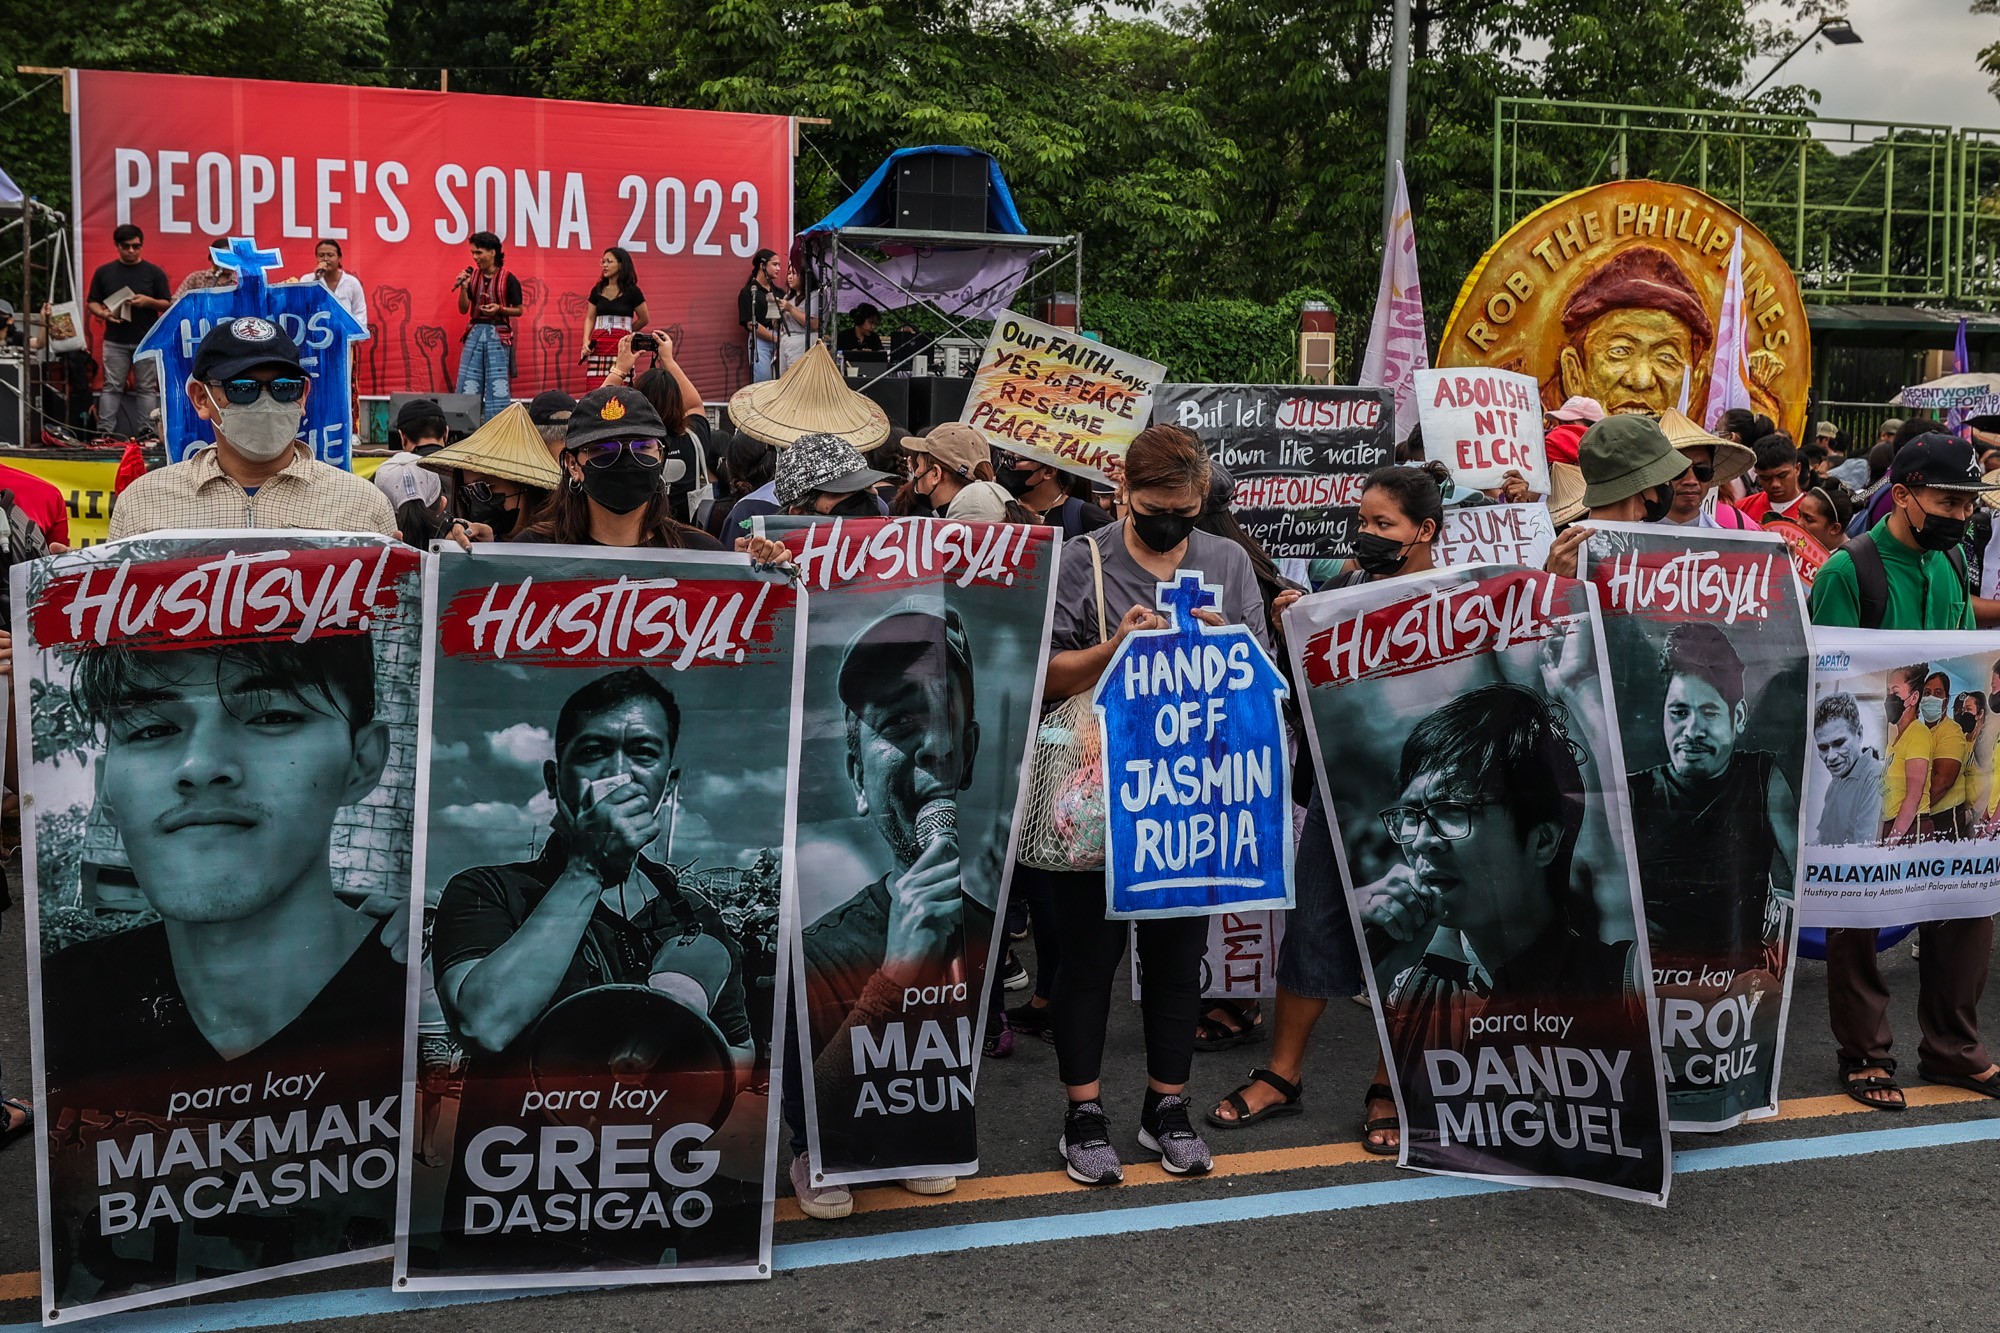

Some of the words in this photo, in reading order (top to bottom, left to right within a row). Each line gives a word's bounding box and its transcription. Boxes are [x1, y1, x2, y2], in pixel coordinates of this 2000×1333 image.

[115, 148, 410, 242] PEOPLE'S
[434, 164, 591, 250] SONA
[618, 175, 760, 257] 2023
[1467, 271, 1535, 351] ROB
[1532, 211, 1603, 272] THE
[180, 311, 334, 358] HDS
[1003, 321, 1045, 350] Our
[1045, 336, 1115, 376] FAITH
[994, 348, 1041, 381] YES
[1045, 371, 1062, 388] to
[1064, 375, 1136, 420] PEACE
[1434, 377, 1530, 412] ABOLISH
[1000, 382, 1104, 436] RESUME
[1177, 400, 1228, 429] But
[1236, 398, 1269, 427] let
[1278, 397, 1382, 428] JUSTICE
[1475, 410, 1518, 438] NTF
[969, 401, 1120, 472] PEACE-TALKS
[1210, 439, 1267, 466] down
[1279, 439, 1317, 466] like
[1323, 439, 1387, 466] water
[1456, 439, 1533, 471] ELCAC
[1260, 539, 1320, 557] tream.
[1432, 508, 1532, 546] ESUME
[1125, 643, 1254, 700] HANDS
[1155, 698, 1227, 747] OFF
[1120, 745, 1272, 812] JASMIN
[1134, 809, 1259, 872] RUBIA
[1803, 887, 1839, 899] Hustisya
[1840, 889, 1862, 899] para
[1864, 888, 1878, 899] kay
[1927, 882, 1959, 894] Palayain
[1960, 880, 1978, 889] lahat
[1979, 882, 1988, 890] ng
[1805, 863, 1900, 883] PALAYAIN
[1906, 859, 1945, 879] ANG
[902, 981, 967, 1013] para
[1652, 968, 1693, 986] ara
[1699, 964, 1735, 991] kay
[1469, 1014, 1528, 1039] para
[1533, 1008, 1574, 1039] kay
[1656, 991, 1765, 1049] ROY
[1423, 1045, 1632, 1102] DANDY
[1685, 1043, 1758, 1084] CRUZ
[166, 1081, 253, 1121] para
[263, 1071, 326, 1100] kay
[520, 1089, 600, 1117] para
[608, 1082, 668, 1115] kay
[96, 1095, 400, 1187] MAKMAK
[1435, 1101, 1643, 1159] MIGUEL
[464, 1123, 721, 1192] GREG
[99, 1148, 396, 1236] BACASNO
[464, 1190, 714, 1235] DASIGAO
